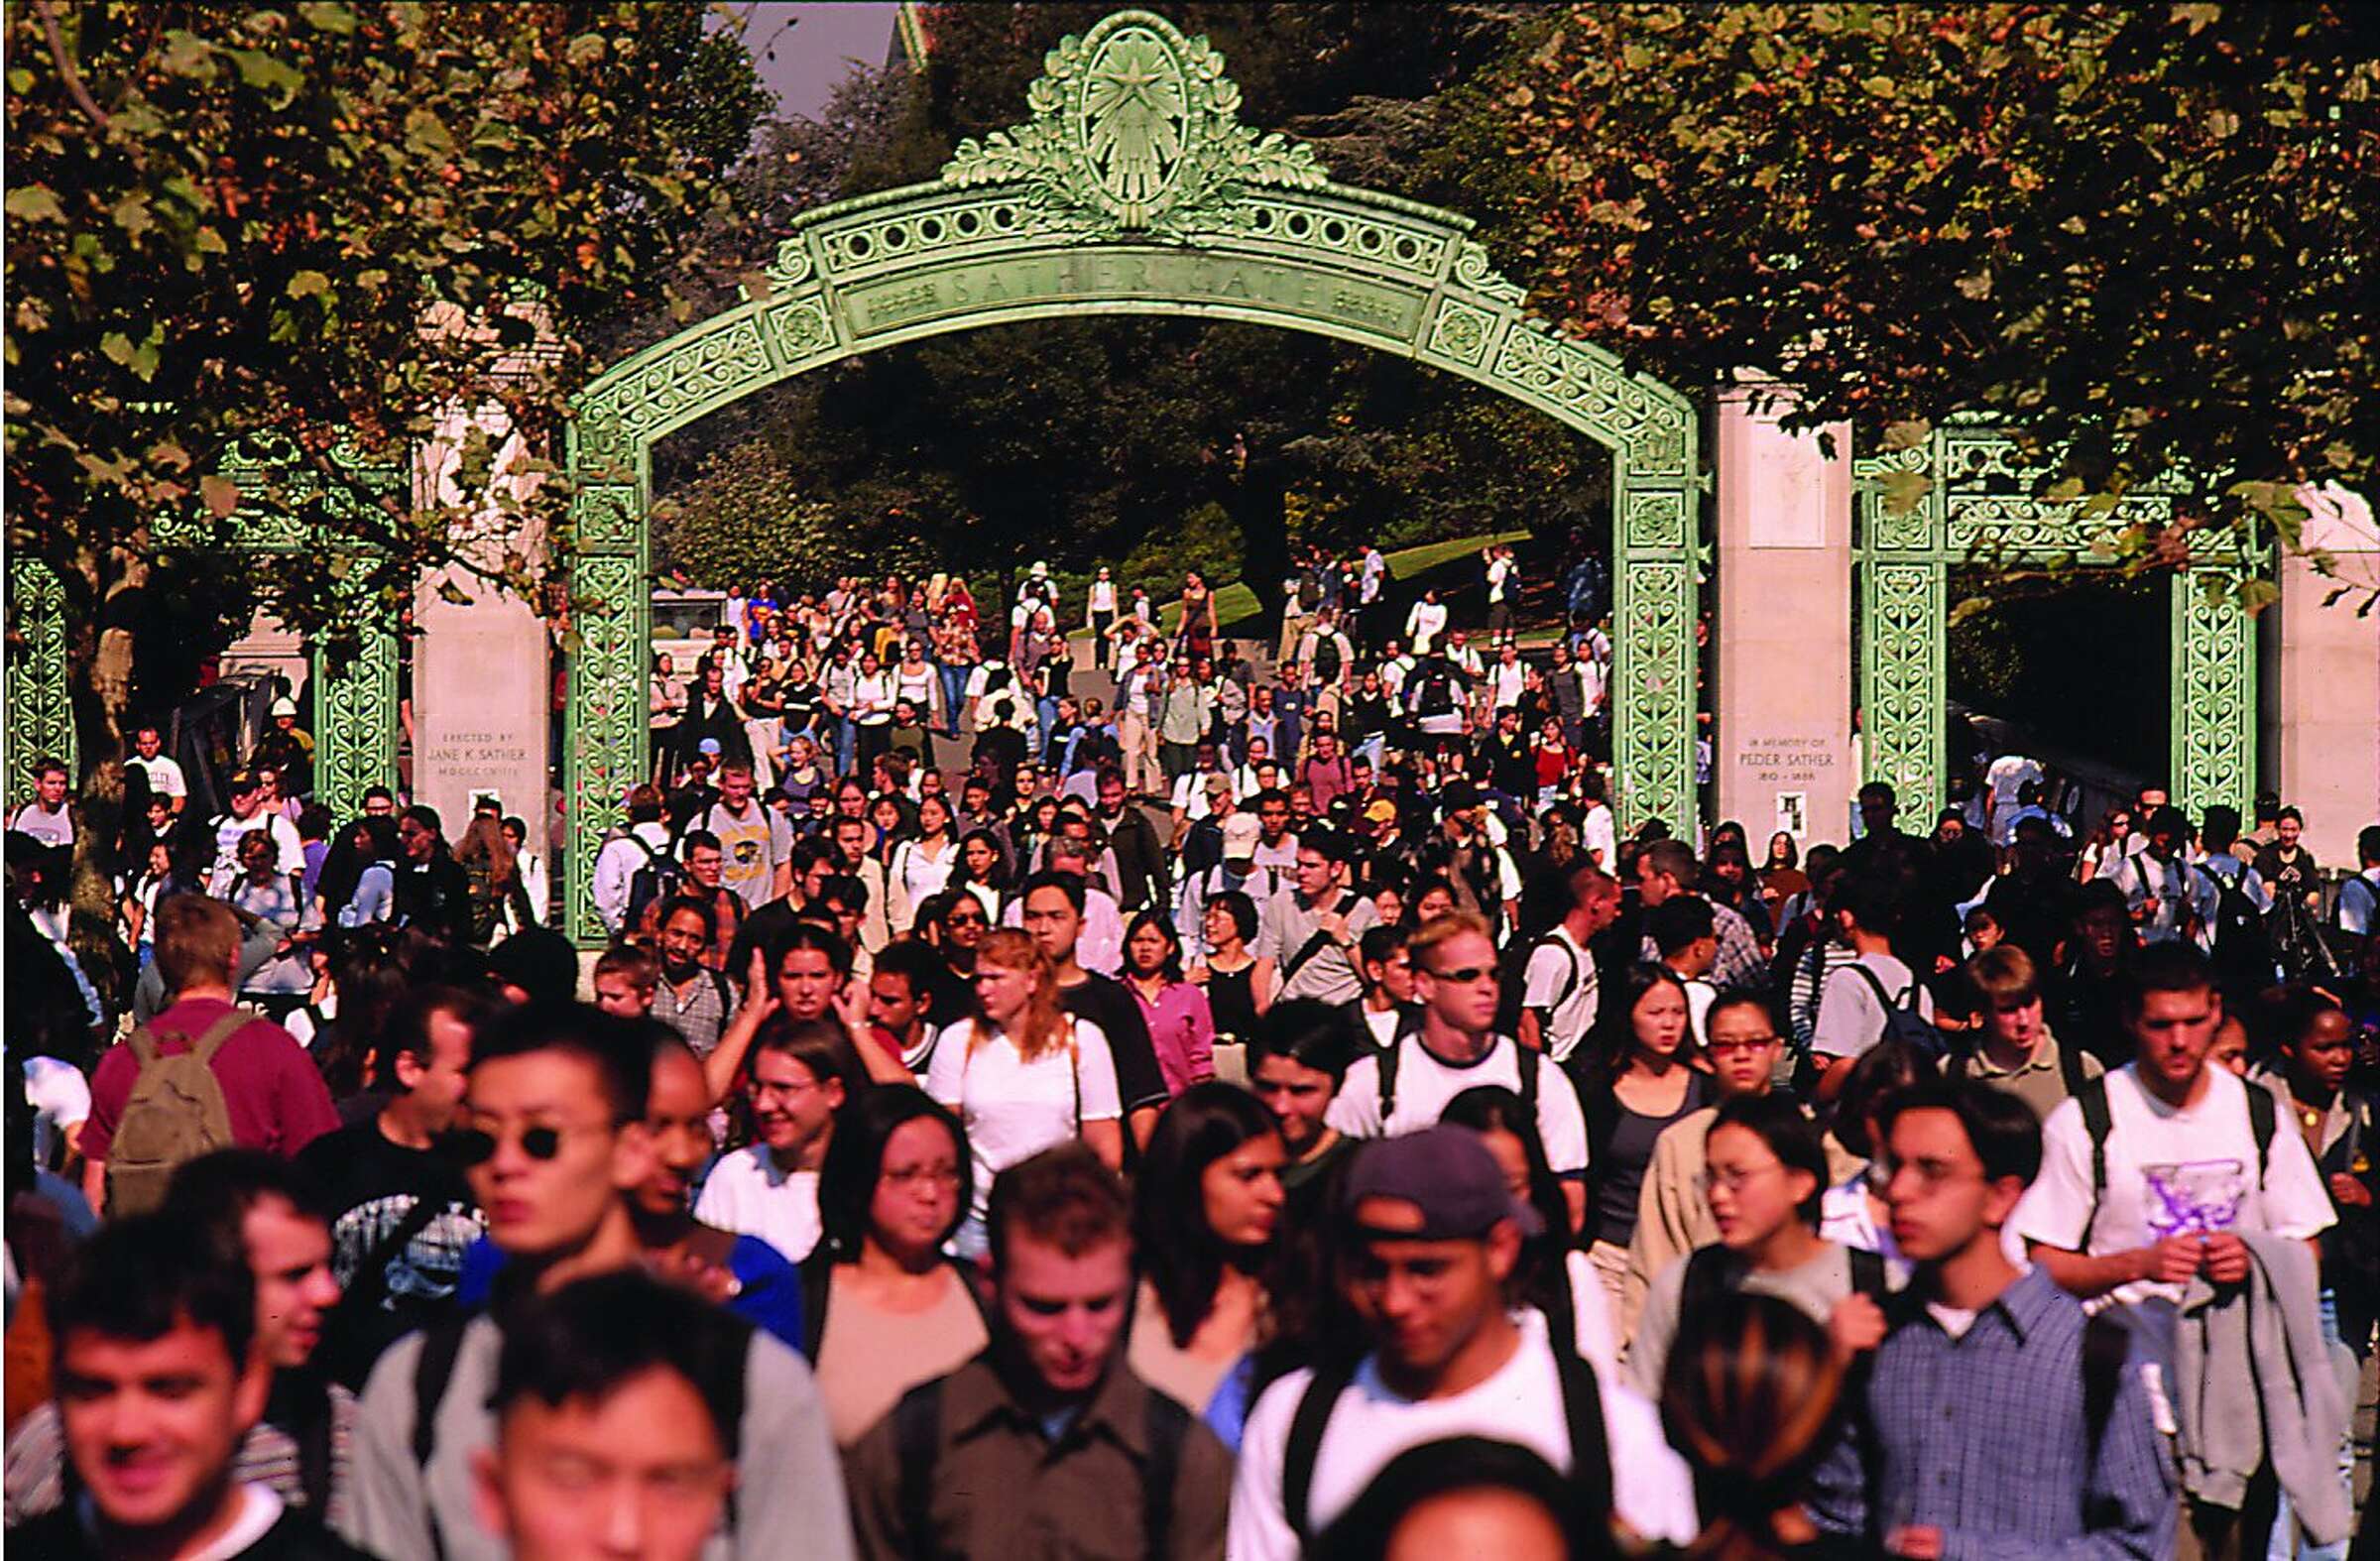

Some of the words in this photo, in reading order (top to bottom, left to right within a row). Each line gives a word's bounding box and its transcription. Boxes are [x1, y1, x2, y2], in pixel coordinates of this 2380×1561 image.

[950, 259, 1152, 303] SATHER
[1189, 258, 1318, 306] GATE
[442, 733, 493, 743] ERECTED
[1762, 738, 1808, 747] MEMORY
[1810, 738, 1826, 748] OF
[427, 748, 459, 761] JANE
[478, 748, 526, 761] SATHER
[1739, 754, 1781, 766] PEDER
[1786, 754, 1835, 767] SATHER
